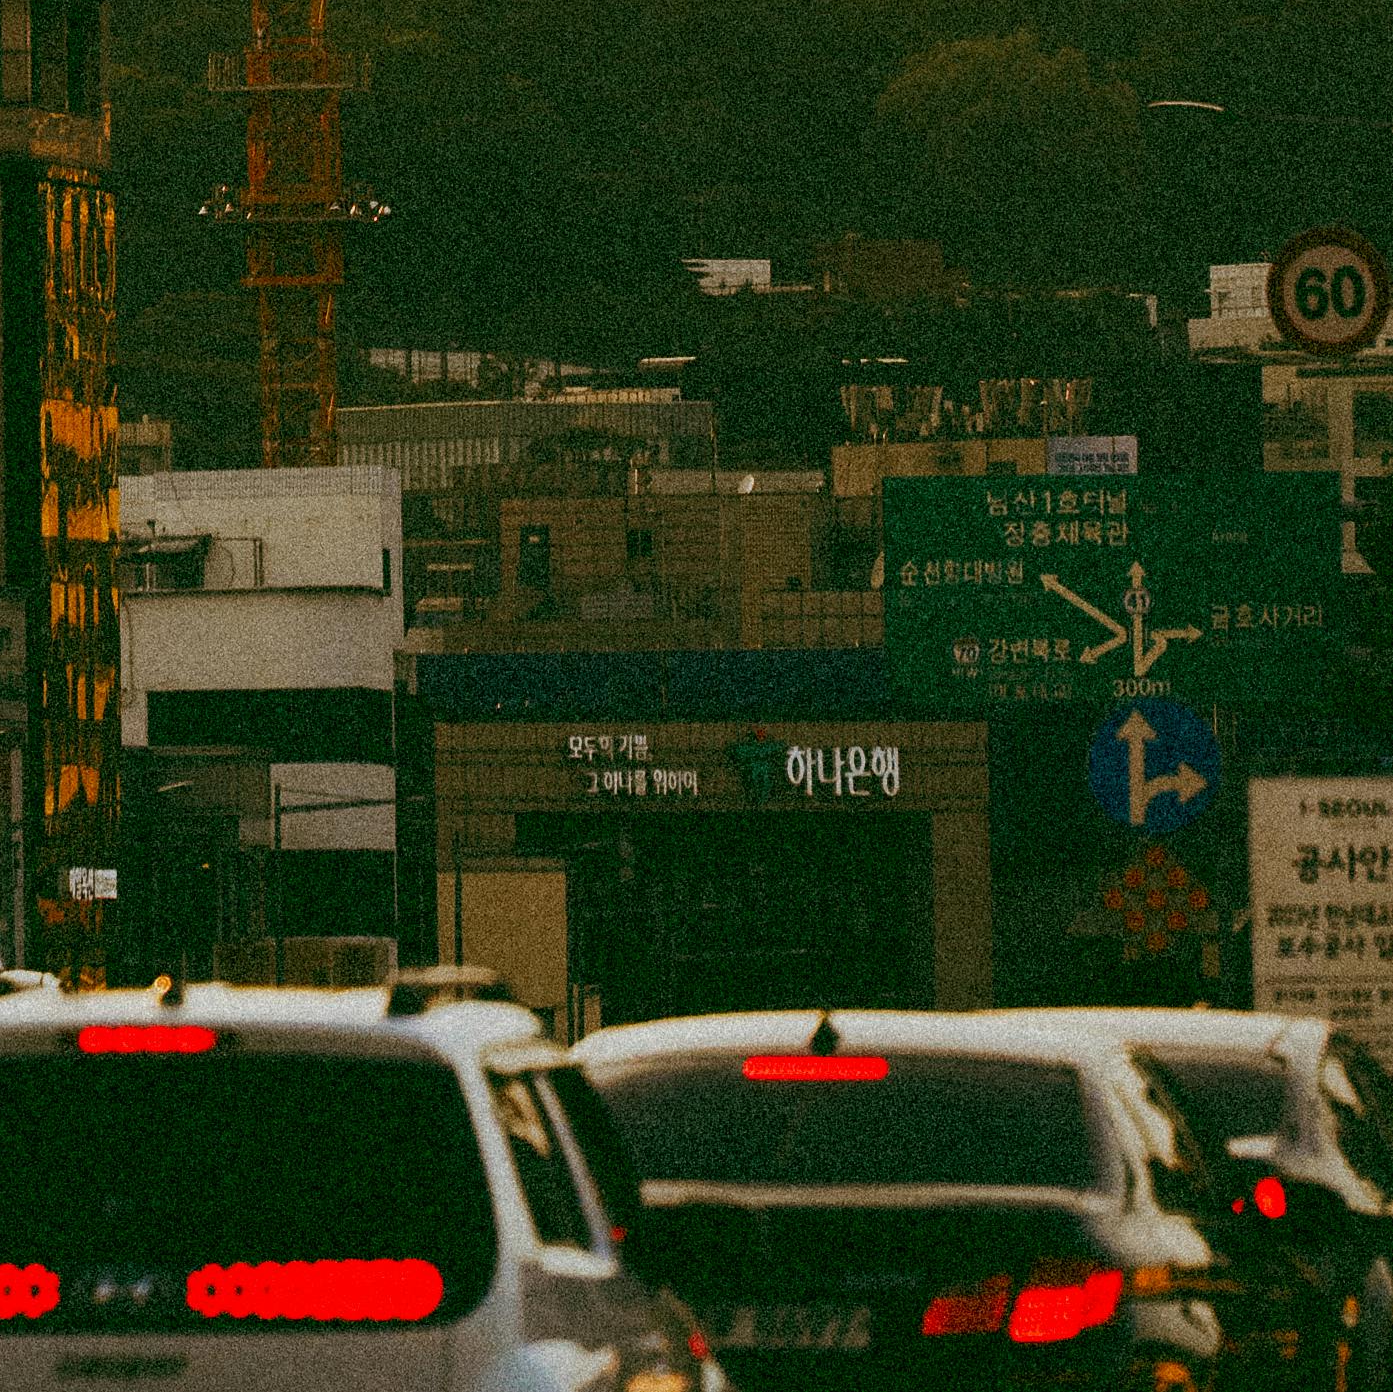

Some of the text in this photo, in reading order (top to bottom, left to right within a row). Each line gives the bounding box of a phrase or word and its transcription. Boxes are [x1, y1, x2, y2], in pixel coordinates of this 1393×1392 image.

[1295, 265, 1366, 320] 60
[1002, 519, 1130, 547] 장충체육관
[987, 637, 1073, 665] 강변북로
[1112, 678, 1172, 698] 300m
[785, 745, 901, 797] 하나은행
